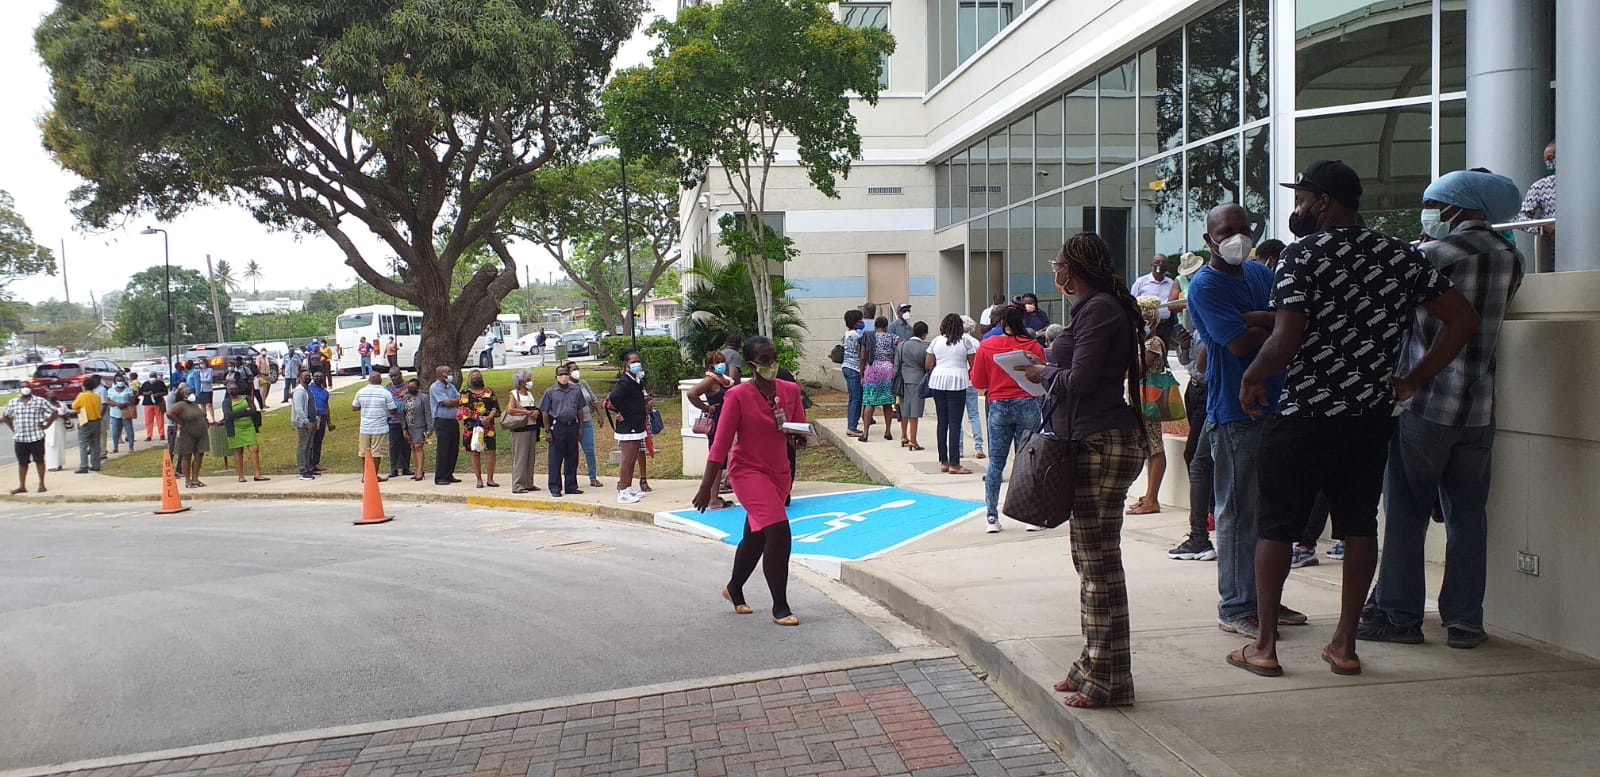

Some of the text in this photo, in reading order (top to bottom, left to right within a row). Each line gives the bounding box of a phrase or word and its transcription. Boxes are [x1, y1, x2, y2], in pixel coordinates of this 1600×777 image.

[1283, 295, 1305, 305] PUMA
[1366, 311, 1387, 327] PUMA
[1352, 342, 1374, 358] PUMA
[1339, 374, 1361, 389] PUMA
